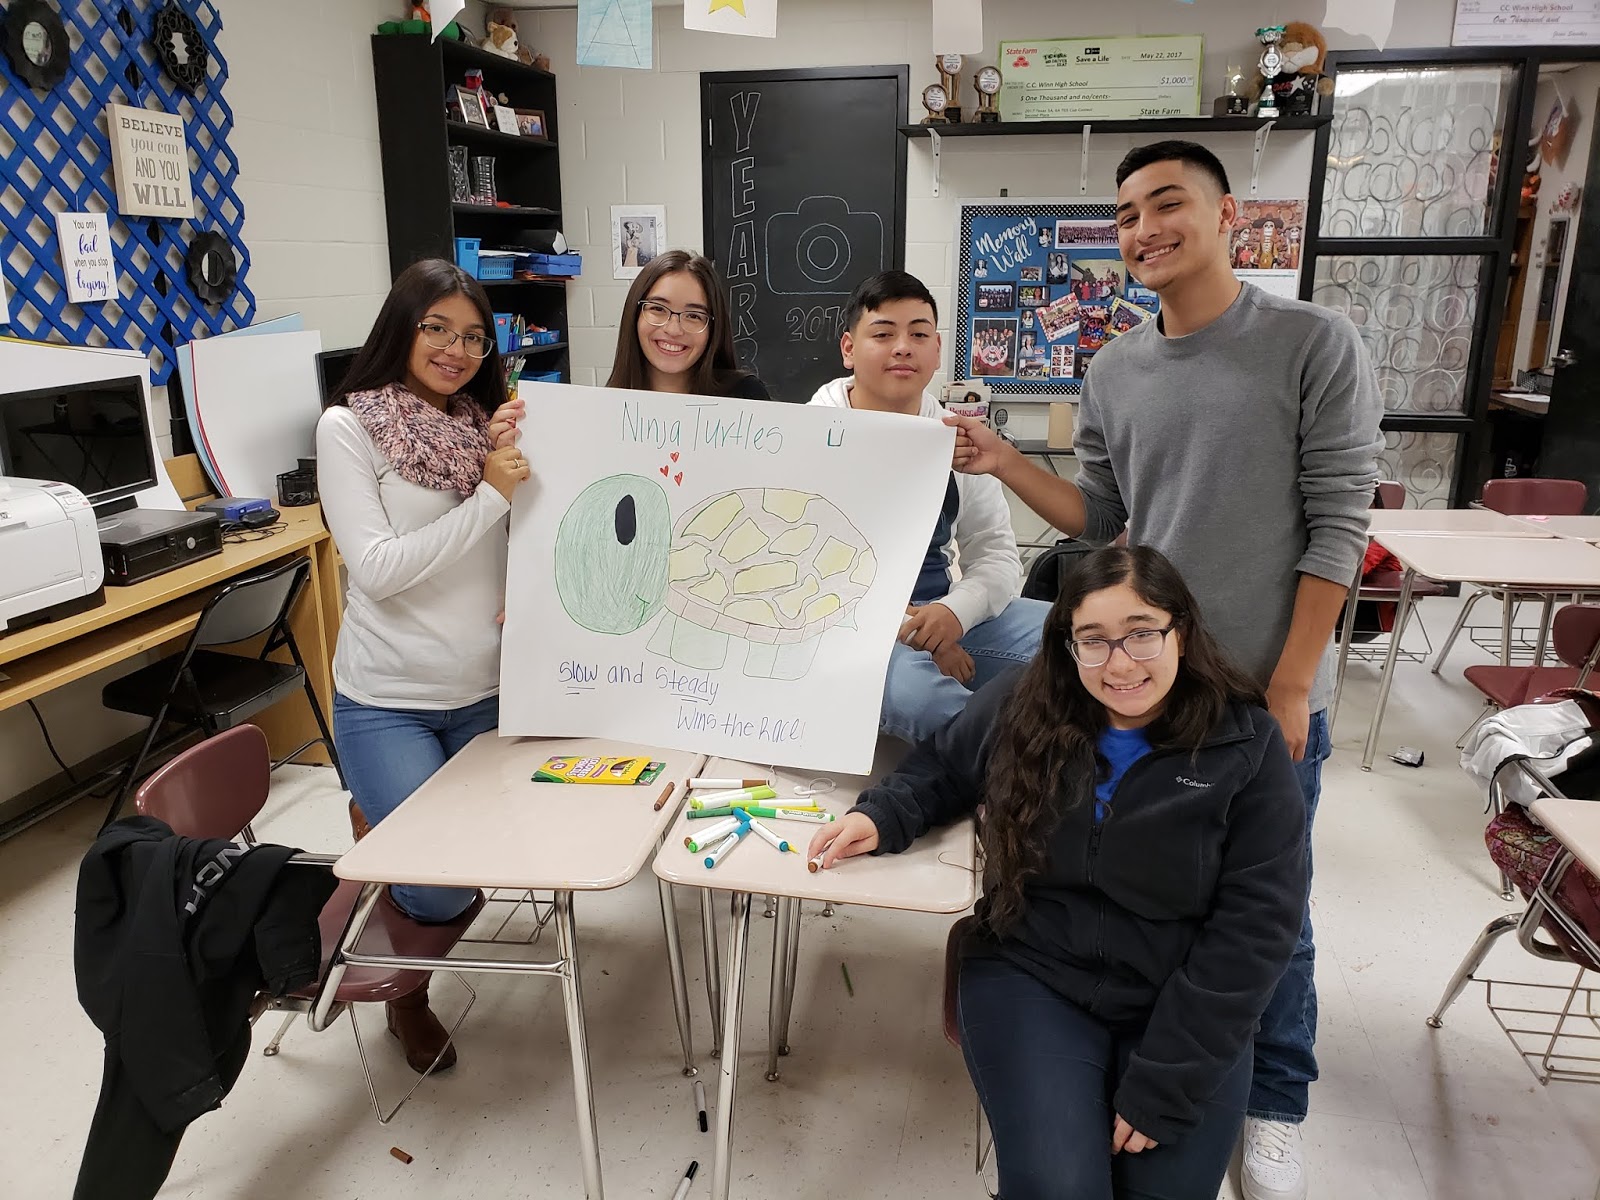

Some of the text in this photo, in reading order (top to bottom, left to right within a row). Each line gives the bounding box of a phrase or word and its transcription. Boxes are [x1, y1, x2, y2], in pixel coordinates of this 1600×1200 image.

[1531, 4, 1548, 13] High
[121, 117, 183, 137] BELIEVE
[130, 137, 180, 155] you can
[135, 156, 181, 182] AND YOU
[133, 183, 187, 208] WILL
[72, 219, 97, 232] You only
[975, 216, 1037, 256] Memory
[78, 233, 99, 256] fail
[989, 234, 1033, 273] Wall
[73, 256, 109, 269] when you stop
[76, 269, 110, 298] trying!
[622, 401, 682, 450] Ninja
[685, 403, 783, 455] Turtles
[607, 661, 644, 684] and
[655, 666, 719, 706] Steady
[677, 705, 717, 732] Wins
[720, 712, 755, 738] the
[1183, 778, 1215, 788] Columb
